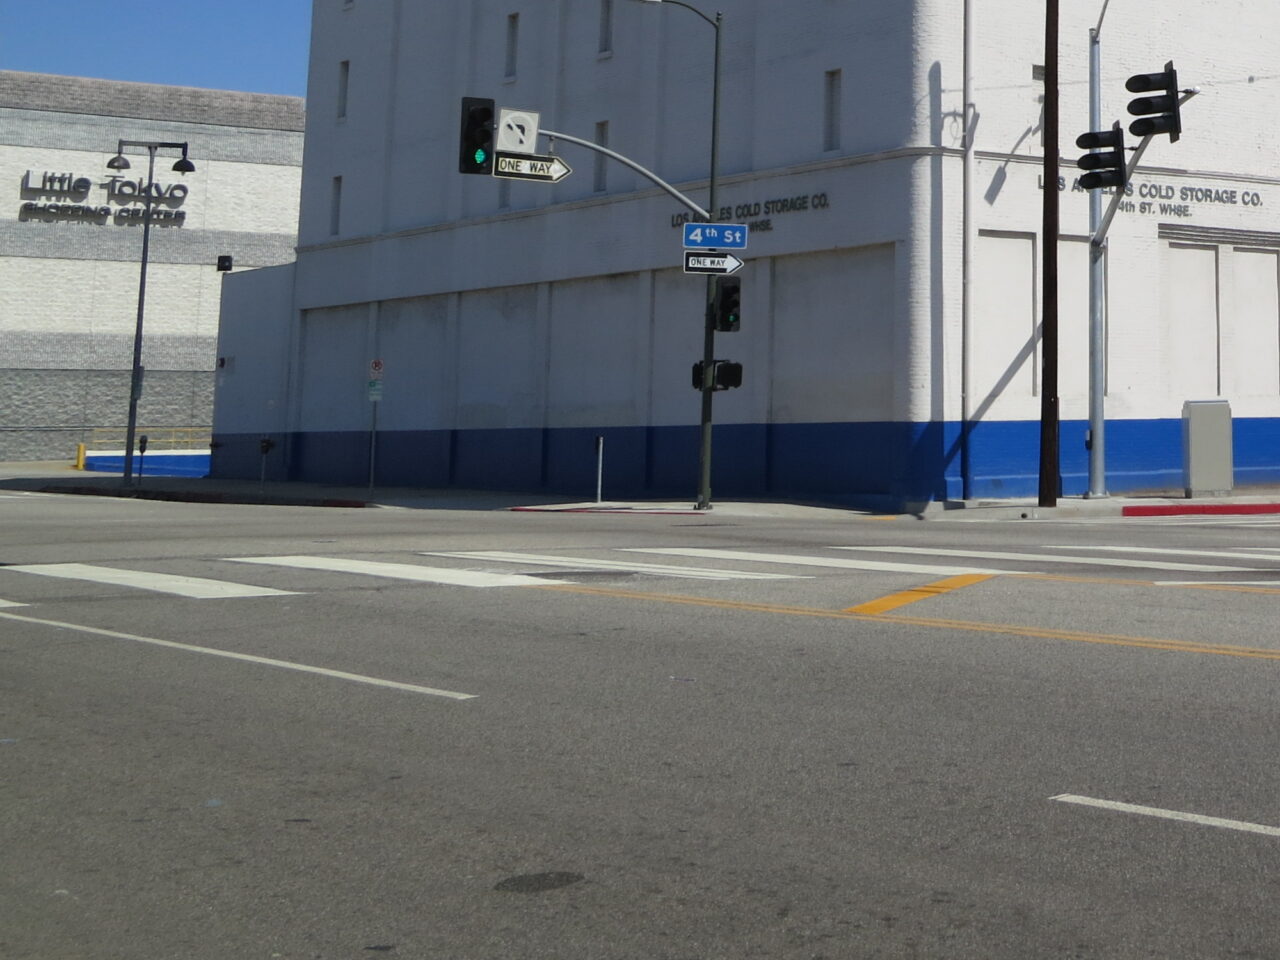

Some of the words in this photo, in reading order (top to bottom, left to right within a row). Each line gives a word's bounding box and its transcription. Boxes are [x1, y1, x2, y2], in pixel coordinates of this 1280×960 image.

[500, 159, 522, 171] ONE
[530, 162, 552, 174] WAY
[23, 170, 91, 198] Little
[103, 174, 189, 203] Tokyo
[1038, 175, 1066, 191] LS
[1139, 183, 1174, 200] COLD
[1180, 187, 1237, 204] STORAGE
[1242, 191, 1263, 206] CO.
[735, 203, 761, 219] COLD
[764, 196, 809, 215] STORAGE
[812, 193, 829, 209] CO.
[1118, 200, 1135, 212] 4th
[1139, 202, 1155, 214] ST.
[689, 228, 717, 243] 4th
[724, 230, 741, 243] St
[690, 258, 707, 266] ONE
[710, 259, 726, 267] WAY
